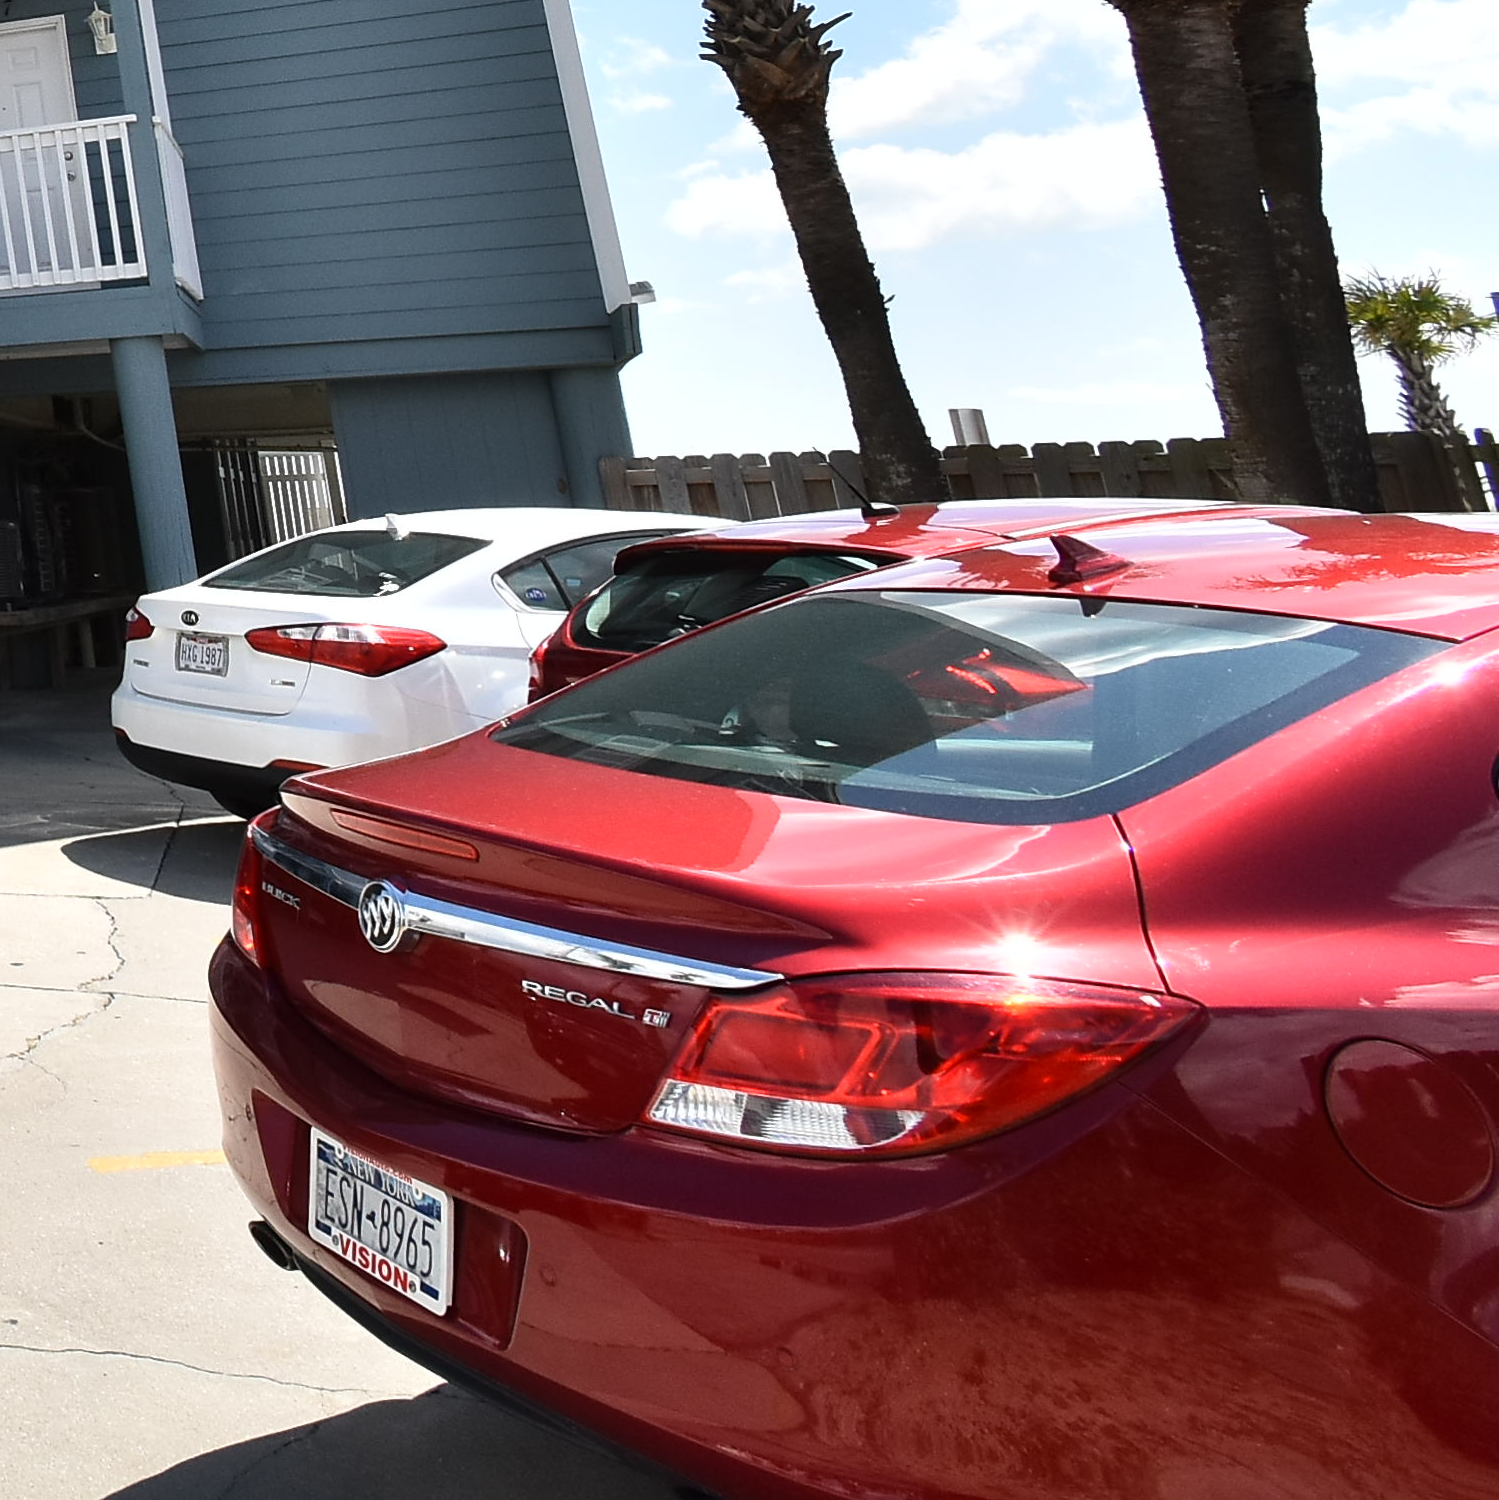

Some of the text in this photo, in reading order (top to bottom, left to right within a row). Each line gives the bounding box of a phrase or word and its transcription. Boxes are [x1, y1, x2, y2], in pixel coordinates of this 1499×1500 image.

[181, 643, 223, 667] HXG 1987
[521, 980, 636, 1020] REGAL
[347, 1155, 416, 1207] NEW YORK
[338, 1233, 411, 1293] VISION
